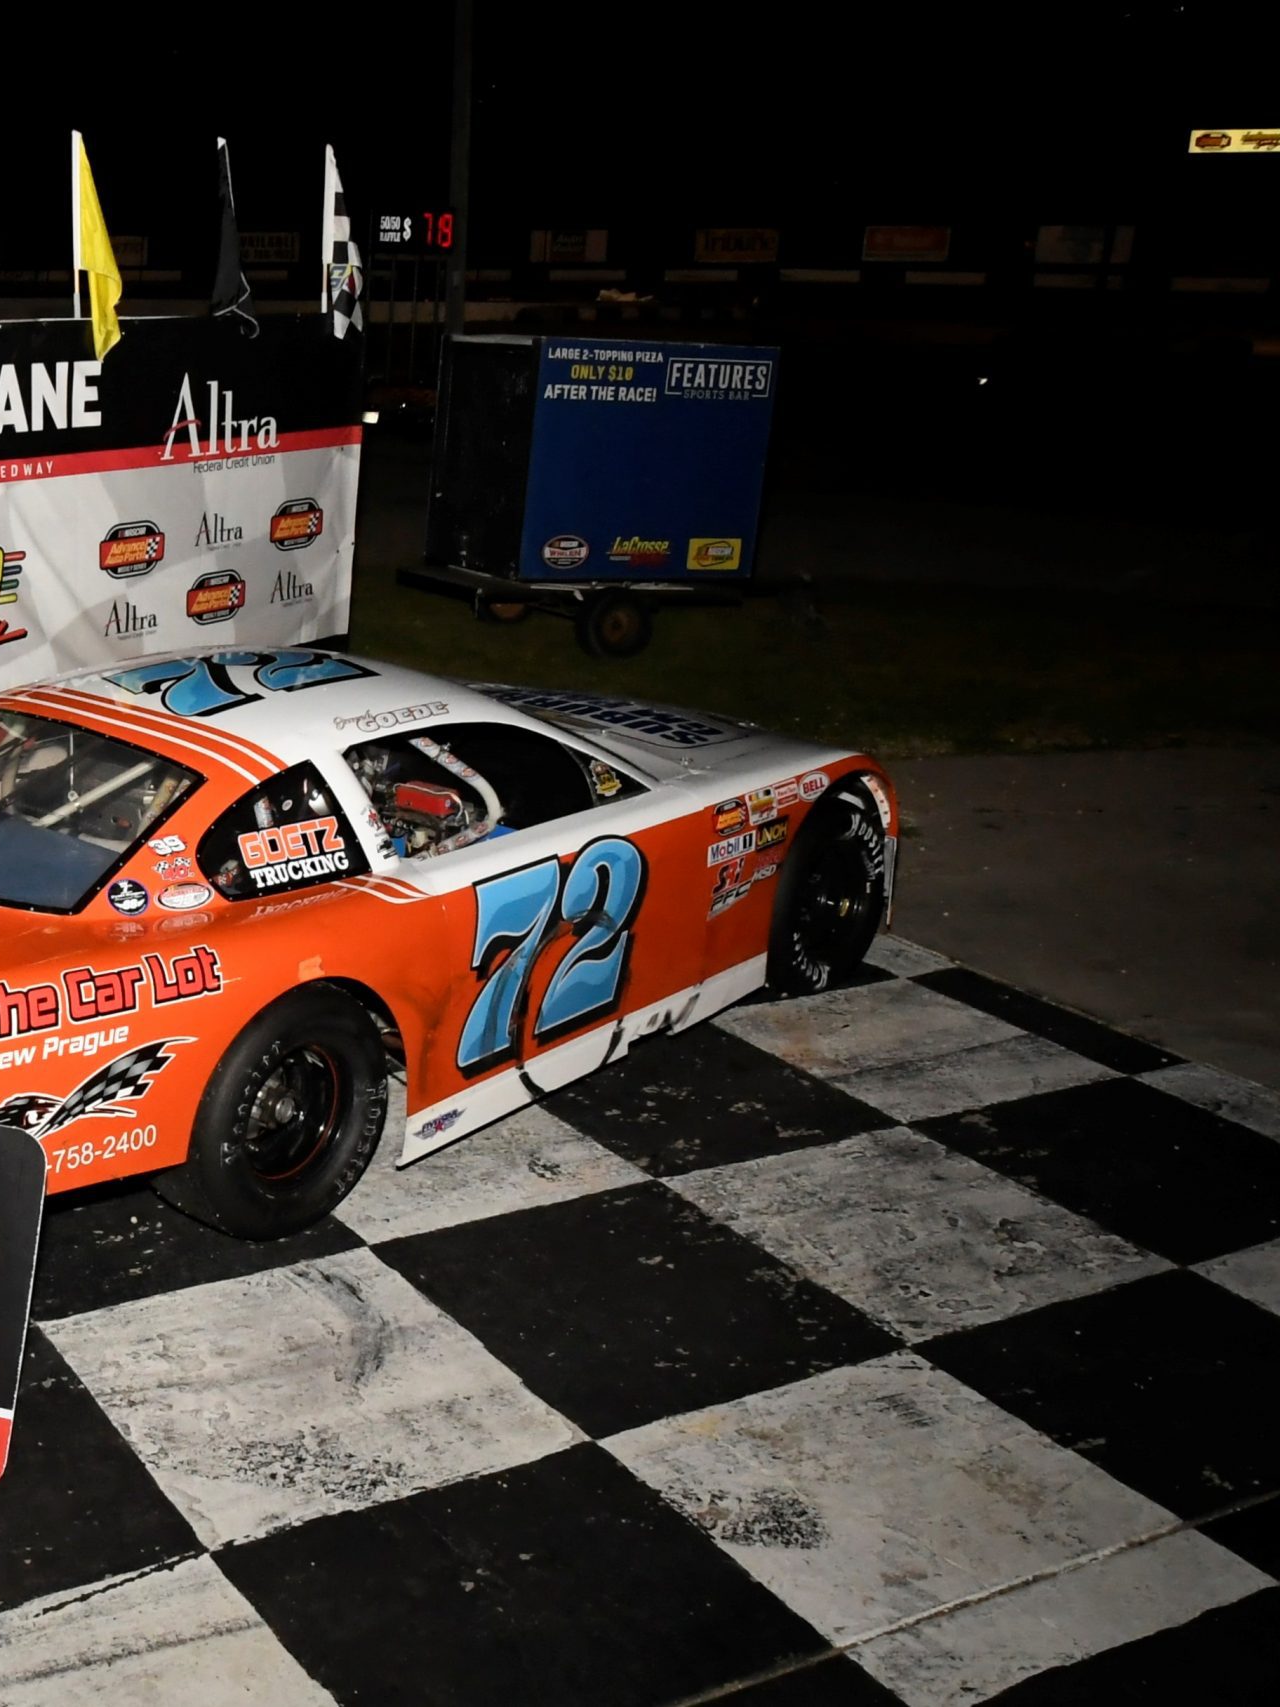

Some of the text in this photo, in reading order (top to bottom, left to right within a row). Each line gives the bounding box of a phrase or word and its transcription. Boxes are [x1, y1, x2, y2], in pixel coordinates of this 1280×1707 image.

[548, 348, 663, 363] LARGE 2-TOPPING PIZZA
[570, 364, 634, 382] ONLY $10
[670, 362, 767, 390] FEATURES
[544, 384, 657, 402] AFTER THE RACE!
[683, 389, 750, 401] SPORTS BAR
[160, 372, 280, 461] Altra
[193, 454, 275, 473] Federal Credit Union
[194, 511, 244, 547] Altra
[612, 536, 670, 553] LaCrosse
[270, 569, 314, 604] Altra
[104, 600, 159, 637] Altra
[356, 700, 450, 732] GOEDE
[803, 778, 825, 794] BELL
[237, 815, 345, 869] GOETZ
[710, 838, 740, 860] Mobil
[757, 822, 788, 846] UNOH
[250, 851, 349, 889] TRUCKING
[456, 834, 648, 1081] 72
[62, 958, 147, 1022] Car
[144, 944, 224, 1008] Lot
[42, 1025, 129, 1061] Prague
